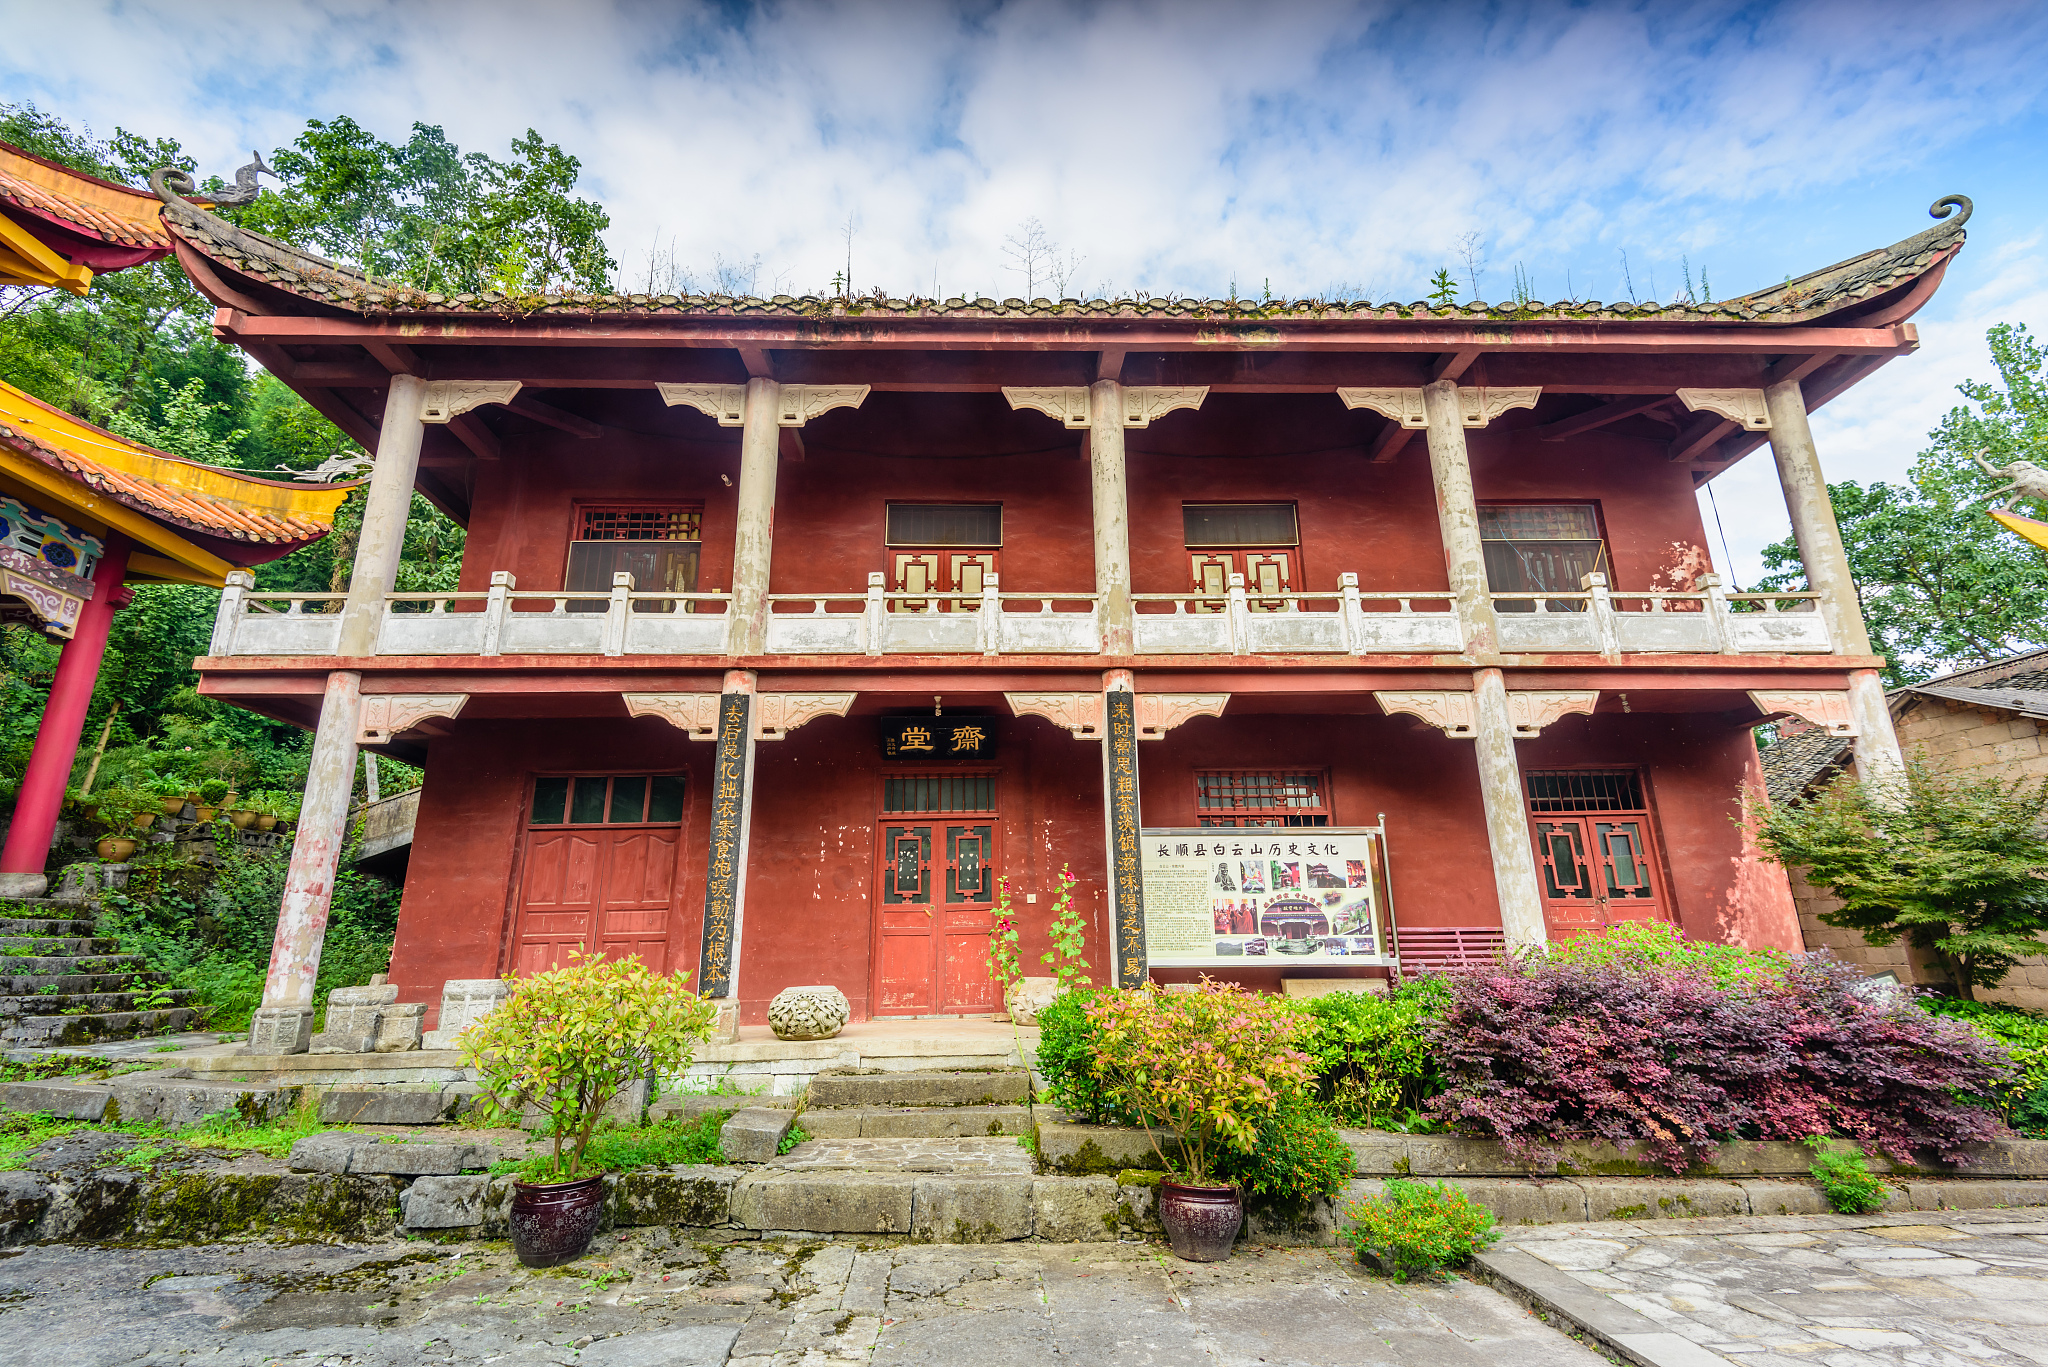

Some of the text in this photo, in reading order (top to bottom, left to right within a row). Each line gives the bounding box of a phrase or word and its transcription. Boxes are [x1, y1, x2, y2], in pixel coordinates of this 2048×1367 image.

[900, 726, 986, 751] 齋堂
[704, 704, 744, 984] 去后总忆拙衣素食饱暖勤为根本
[1112, 701, 1142, 976] 来时常思粗茶淡饭滋味得之不易
[1157, 842, 1340, 857] 长顺县白云山历史文化
